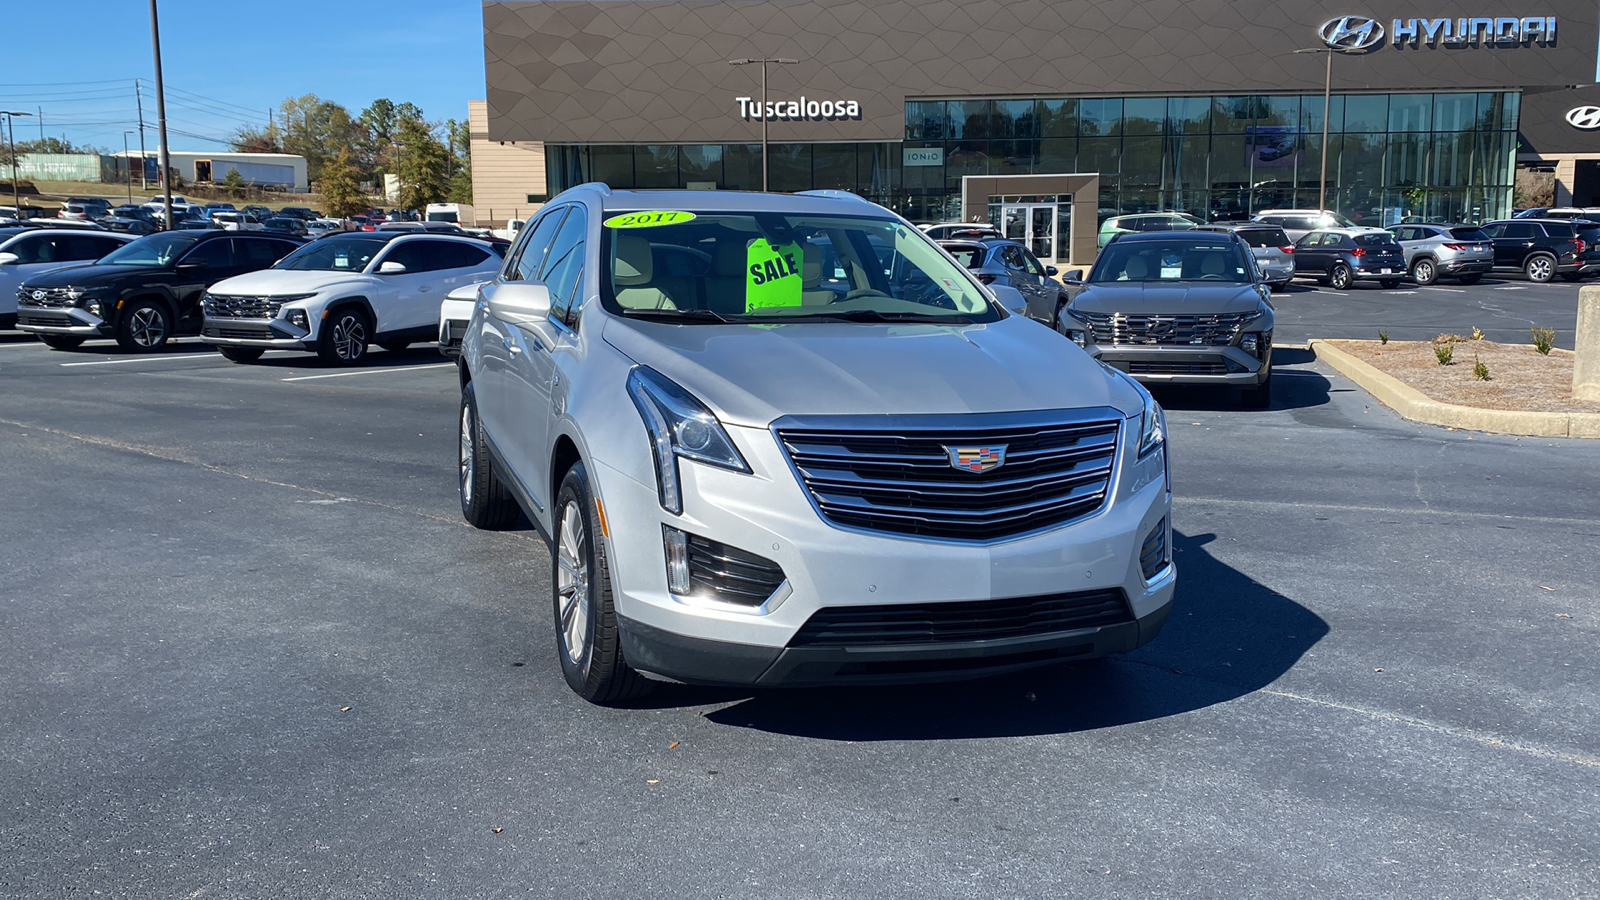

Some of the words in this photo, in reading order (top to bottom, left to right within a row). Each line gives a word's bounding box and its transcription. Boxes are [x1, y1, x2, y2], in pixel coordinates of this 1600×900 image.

[1392, 16, 1557, 44] HYUNDAI
[735, 95, 860, 118] Tuscaloosa
[620, 212, 679, 226] 2017
[749, 252, 799, 286] SALE
